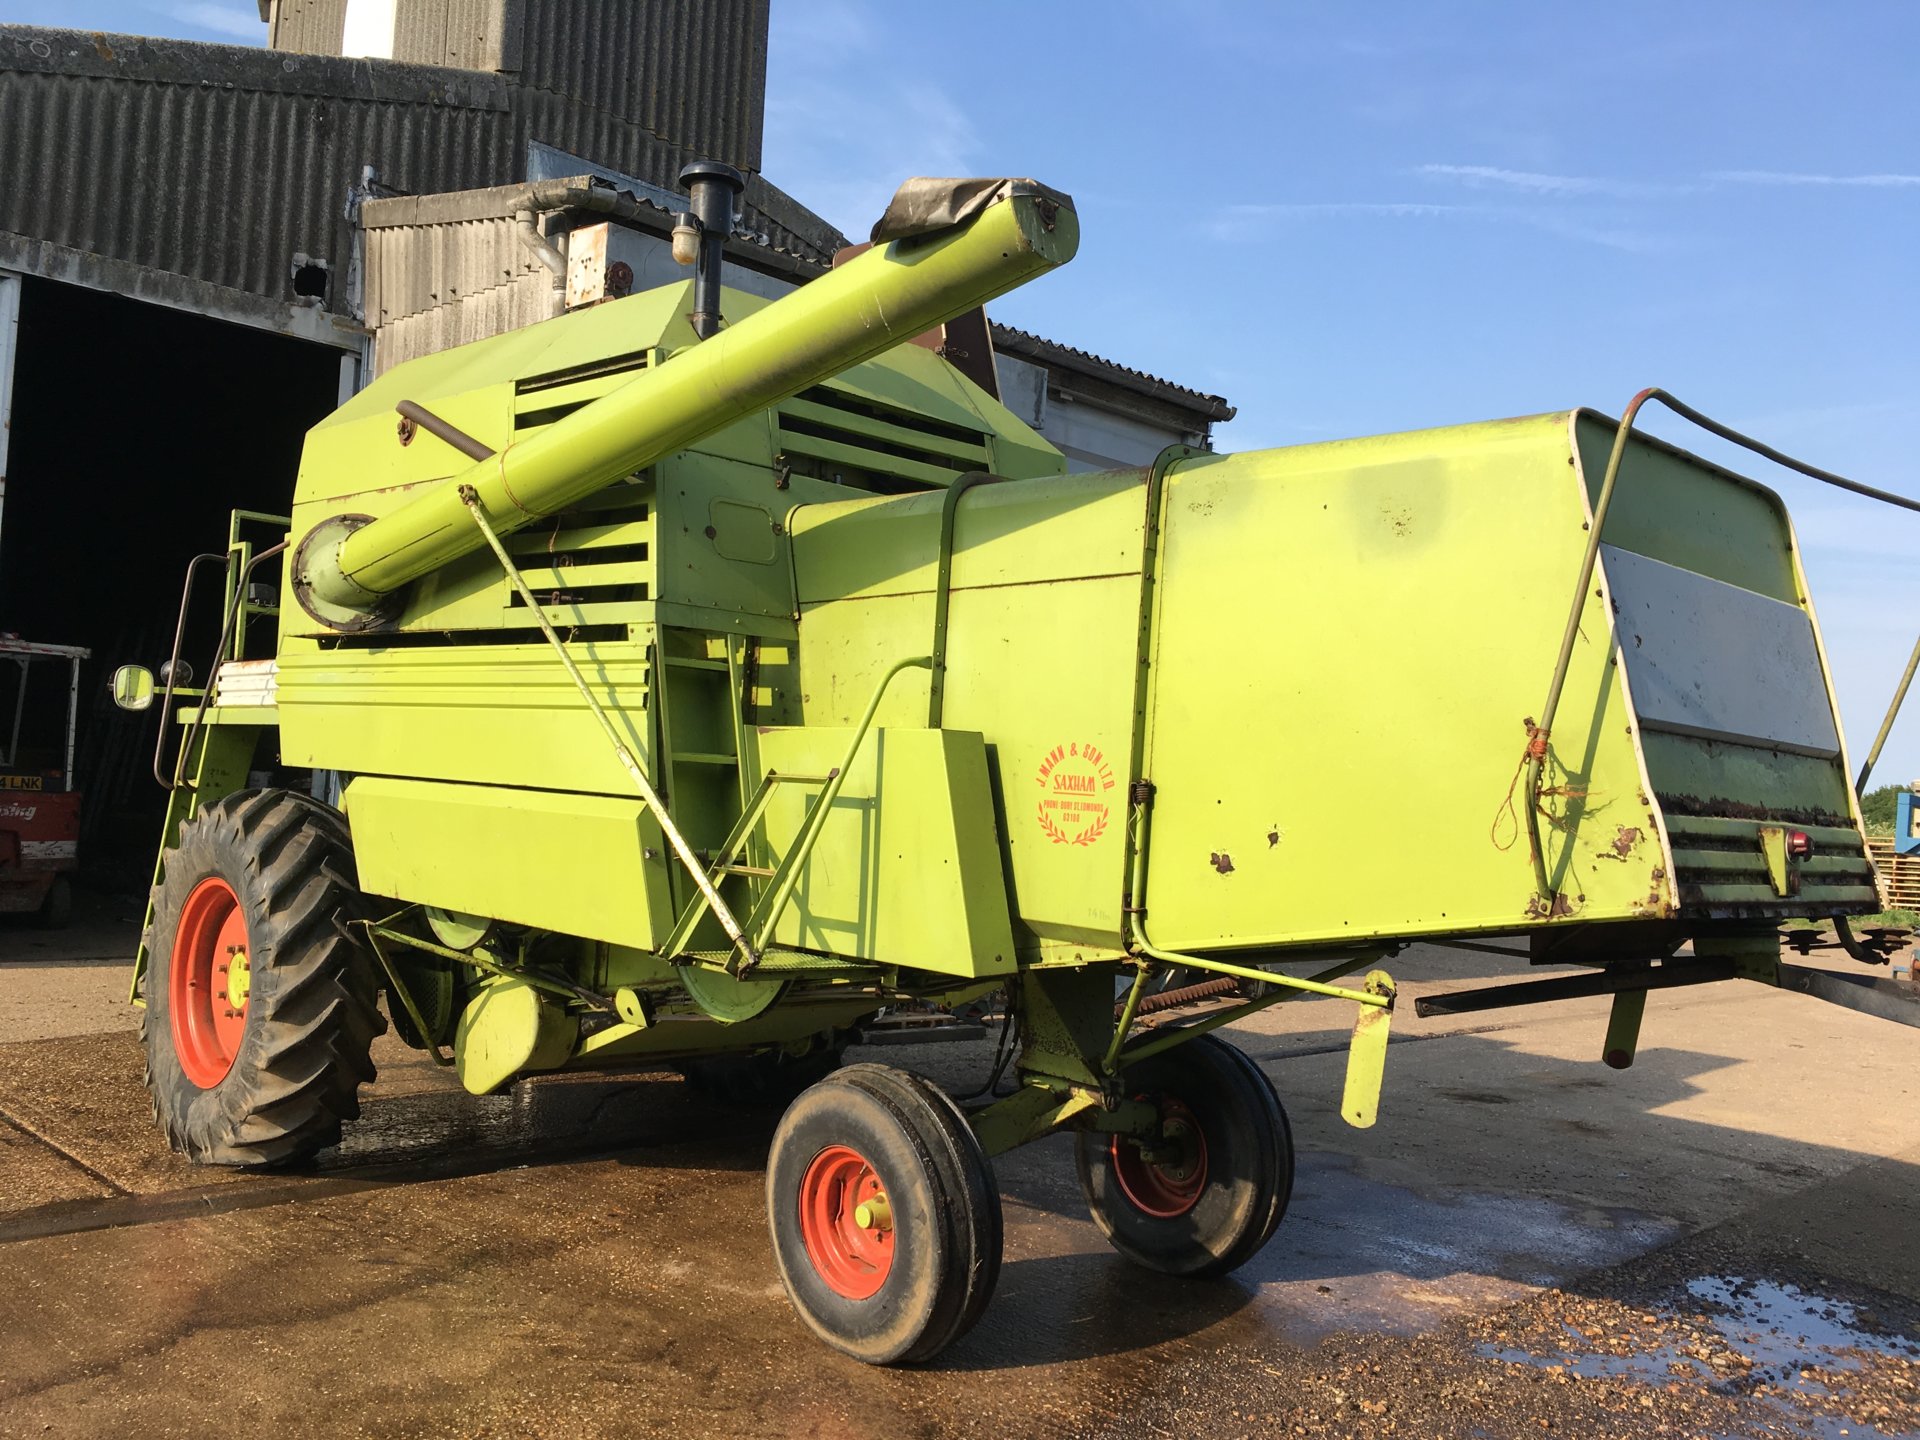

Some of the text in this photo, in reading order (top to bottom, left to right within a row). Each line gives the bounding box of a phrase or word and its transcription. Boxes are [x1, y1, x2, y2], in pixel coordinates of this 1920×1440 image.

[1070, 742, 1078, 757] &
[1083, 744, 1103, 766] SON
[11, 777, 40, 789] LNK
[1053, 774, 1096, 792] SAXHAM
